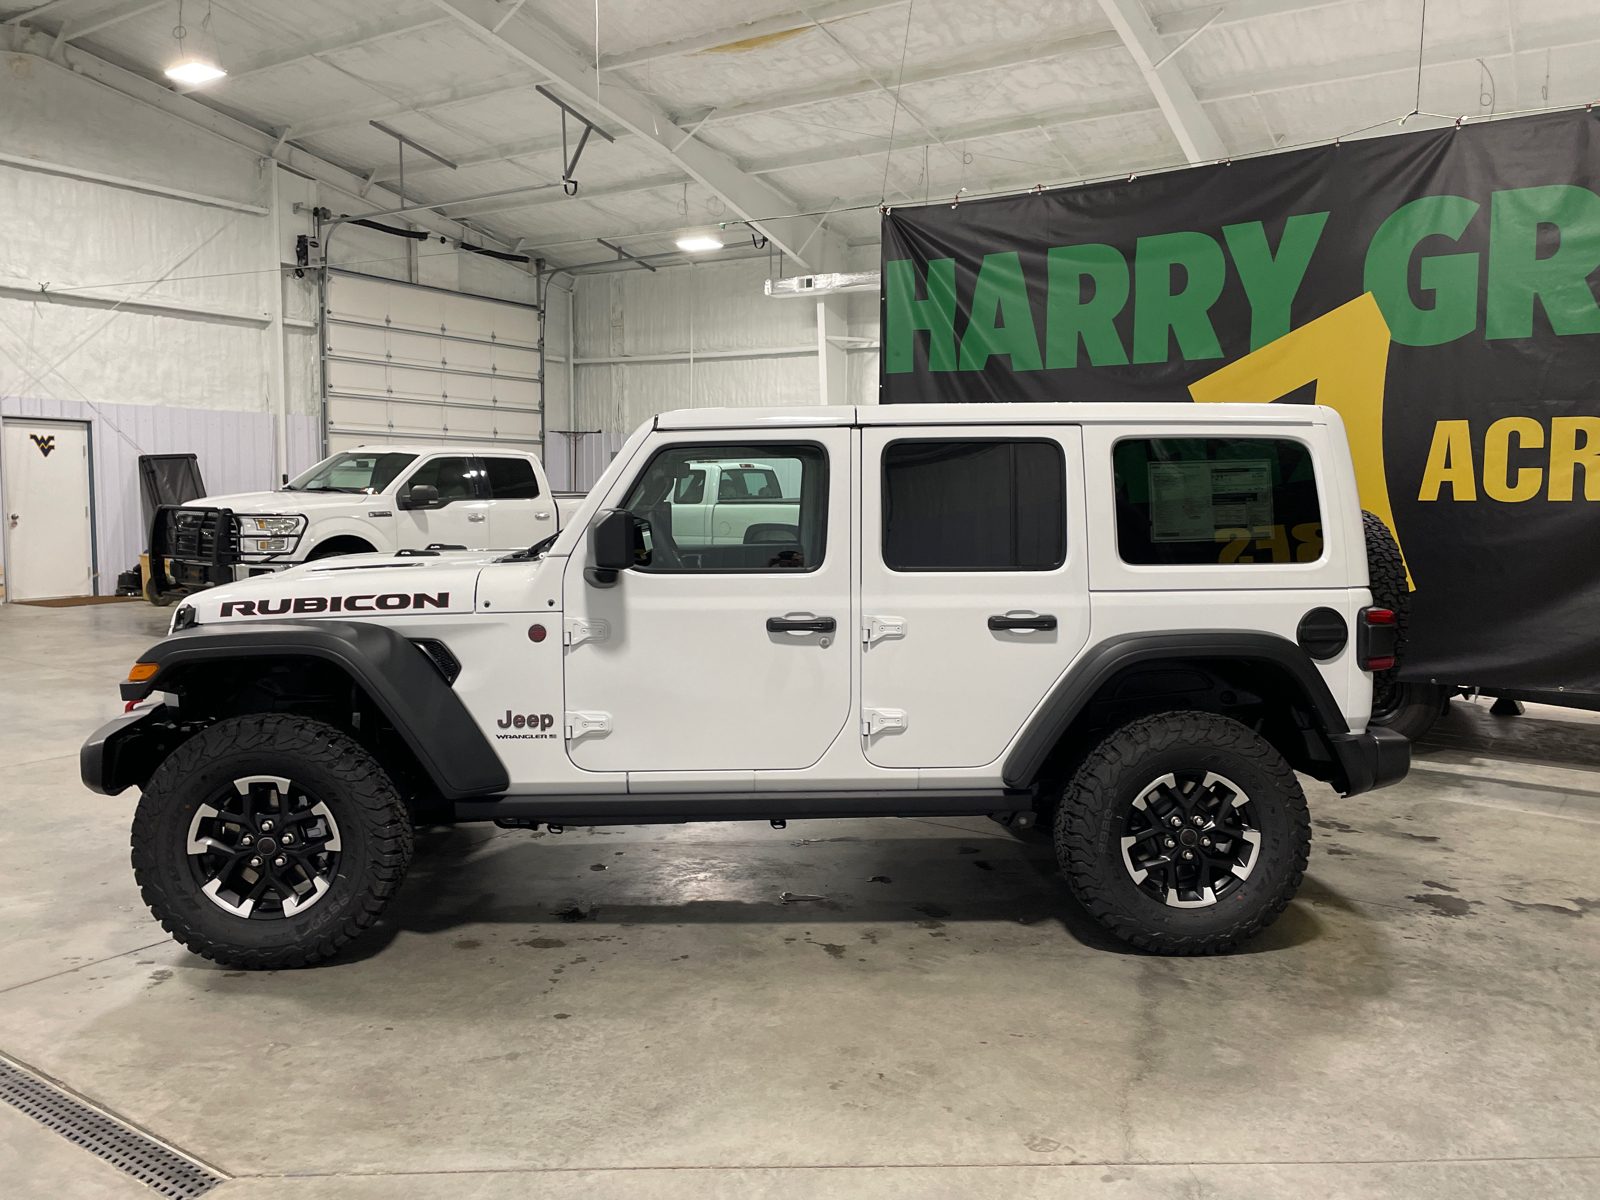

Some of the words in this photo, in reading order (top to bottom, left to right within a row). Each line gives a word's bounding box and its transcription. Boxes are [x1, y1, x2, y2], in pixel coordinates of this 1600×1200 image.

[886, 211, 1331, 374] HARRY
[1363, 184, 1600, 347] GR
[1417, 416, 1600, 503] ACR
[220, 592, 450, 617] RUBICON
[497, 710, 554, 732] Jeep
